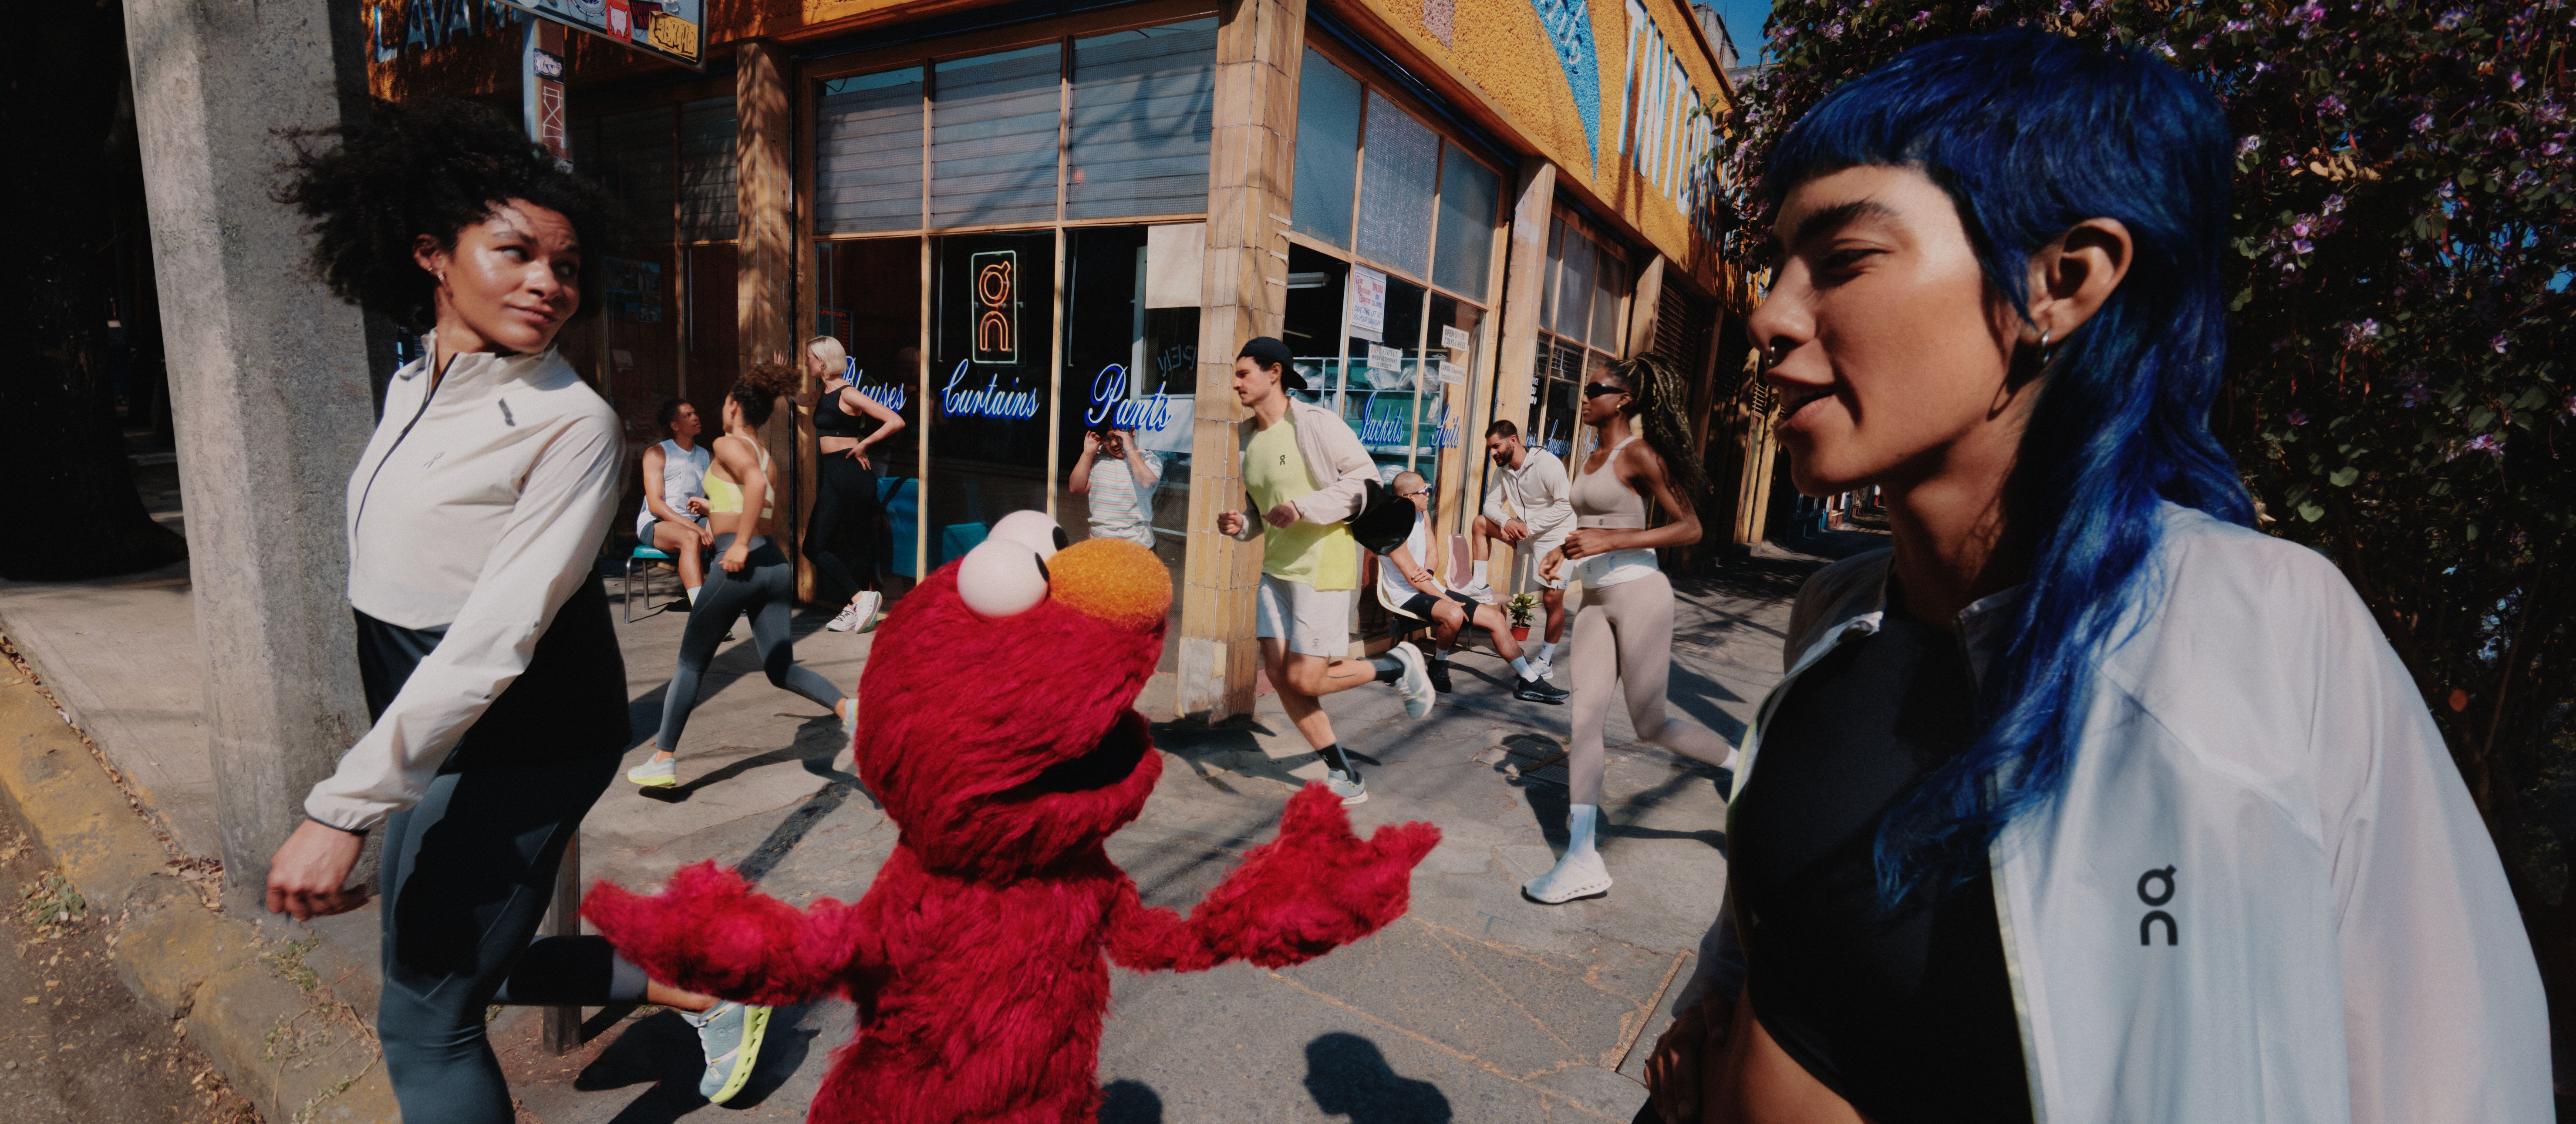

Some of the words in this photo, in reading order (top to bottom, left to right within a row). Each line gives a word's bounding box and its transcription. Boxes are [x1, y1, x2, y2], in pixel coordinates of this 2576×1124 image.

[374, 0, 523, 64] LAVAN
[1372, 283, 1383, 294] OFFERS
[1372, 300, 1382, 309] CLEANING
[1368, 317, 1381, 326] LAUNDRY
[1445, 329, 1454, 338] OPEN
[1457, 341, 1466, 349] WEEK
[1382, 348, 1397, 357] COFFEE
[1441, 363, 1450, 372] LARGE
[940, 358, 1040, 421] Curtains
[1085, 363, 1172, 432] Pants
[1359, 390, 1404, 451] Jackets
[1430, 404, 1460, 449] Suits
